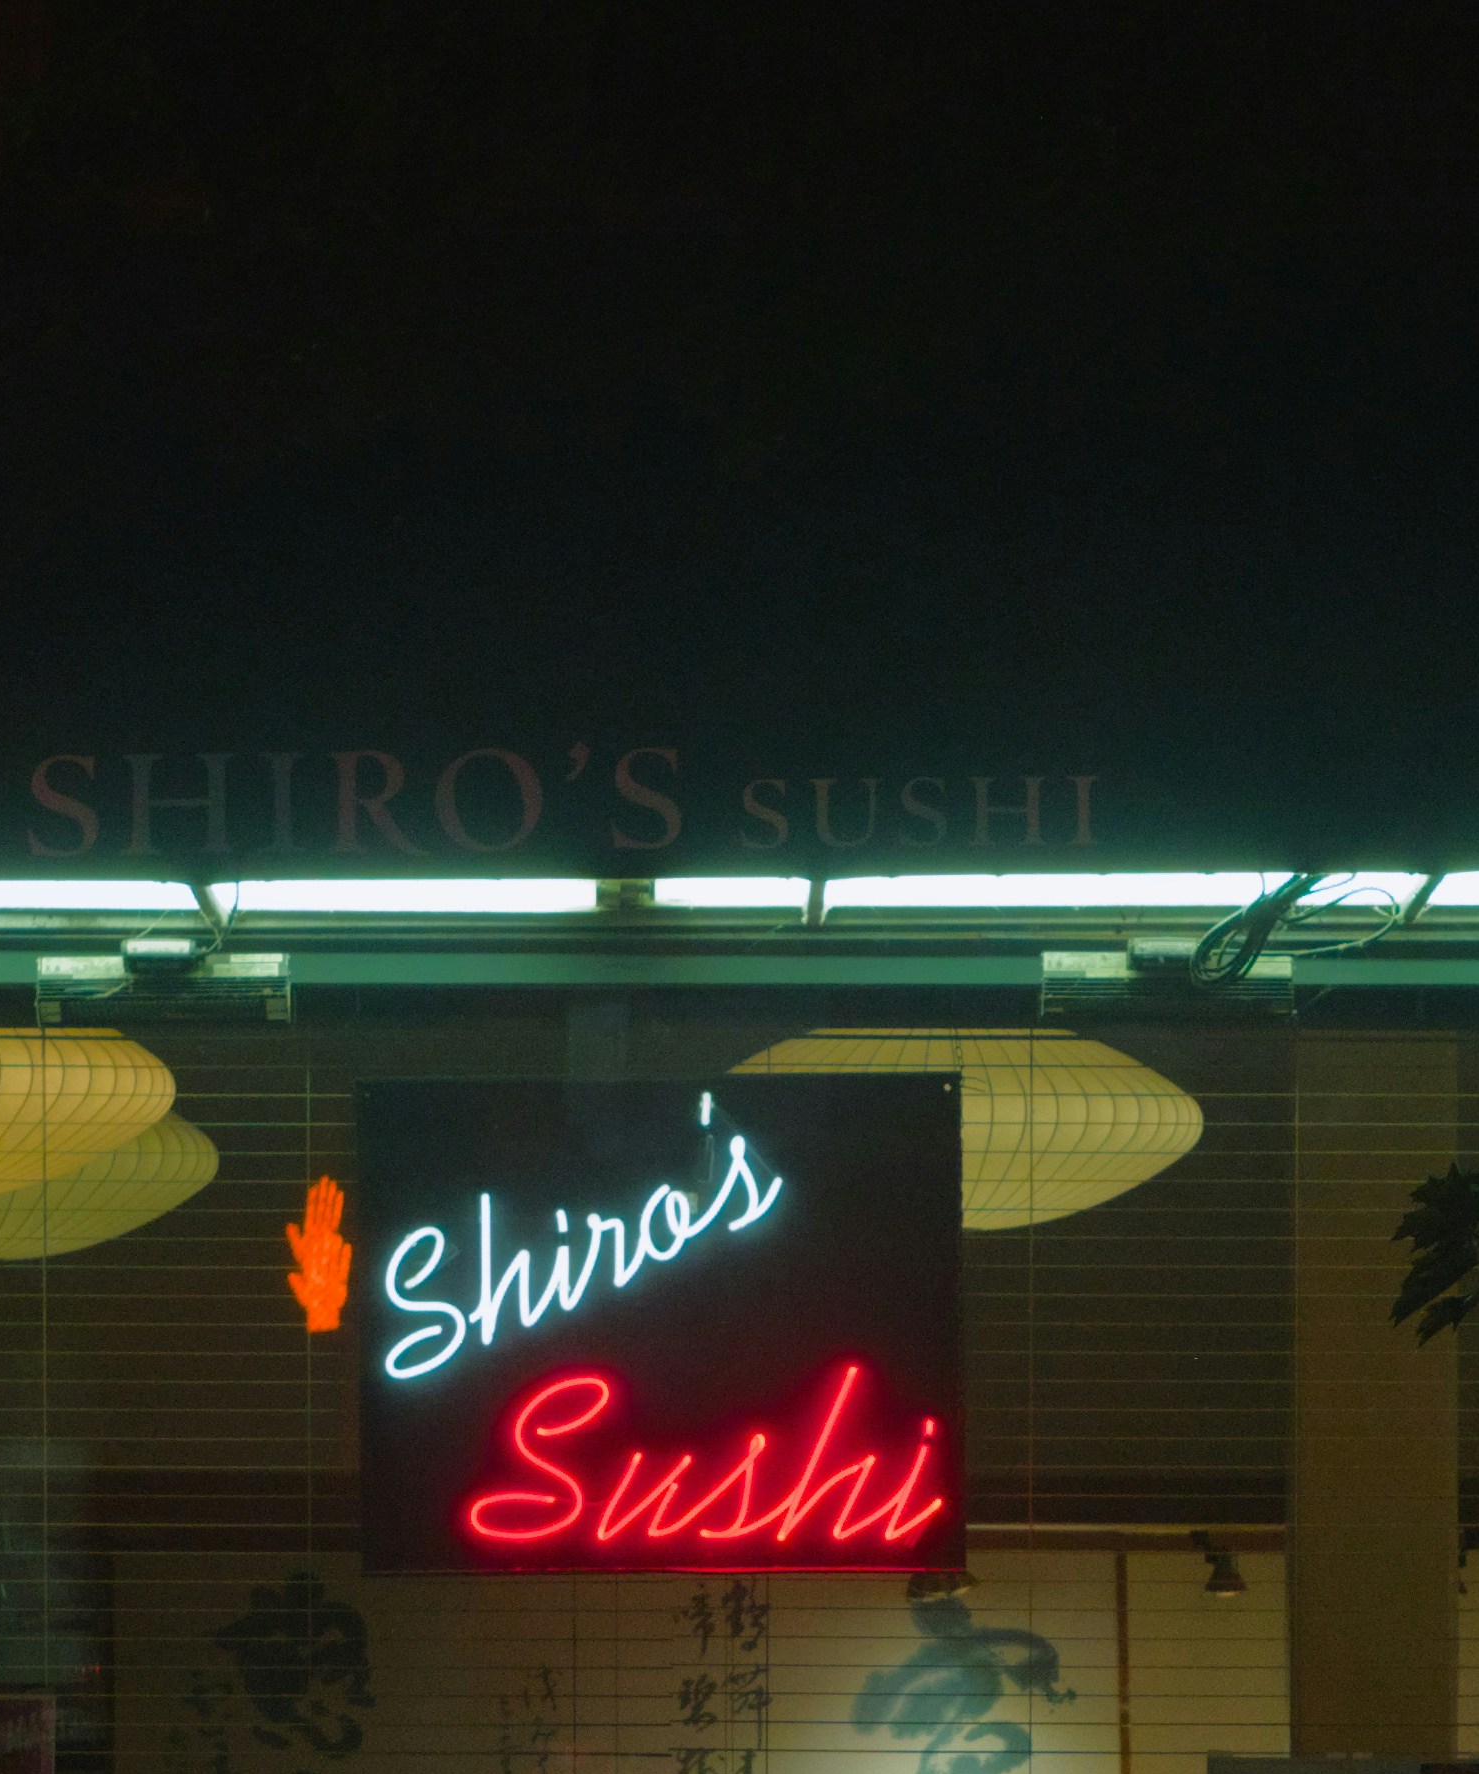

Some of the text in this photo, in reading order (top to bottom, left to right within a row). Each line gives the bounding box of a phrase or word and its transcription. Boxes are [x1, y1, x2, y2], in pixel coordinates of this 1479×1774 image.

[27, 741, 1100, 859] SHIRO'S SUSHI
[383, 1090, 784, 1381] Shiro's
[468, 1364, 944, 1544] Sushi
